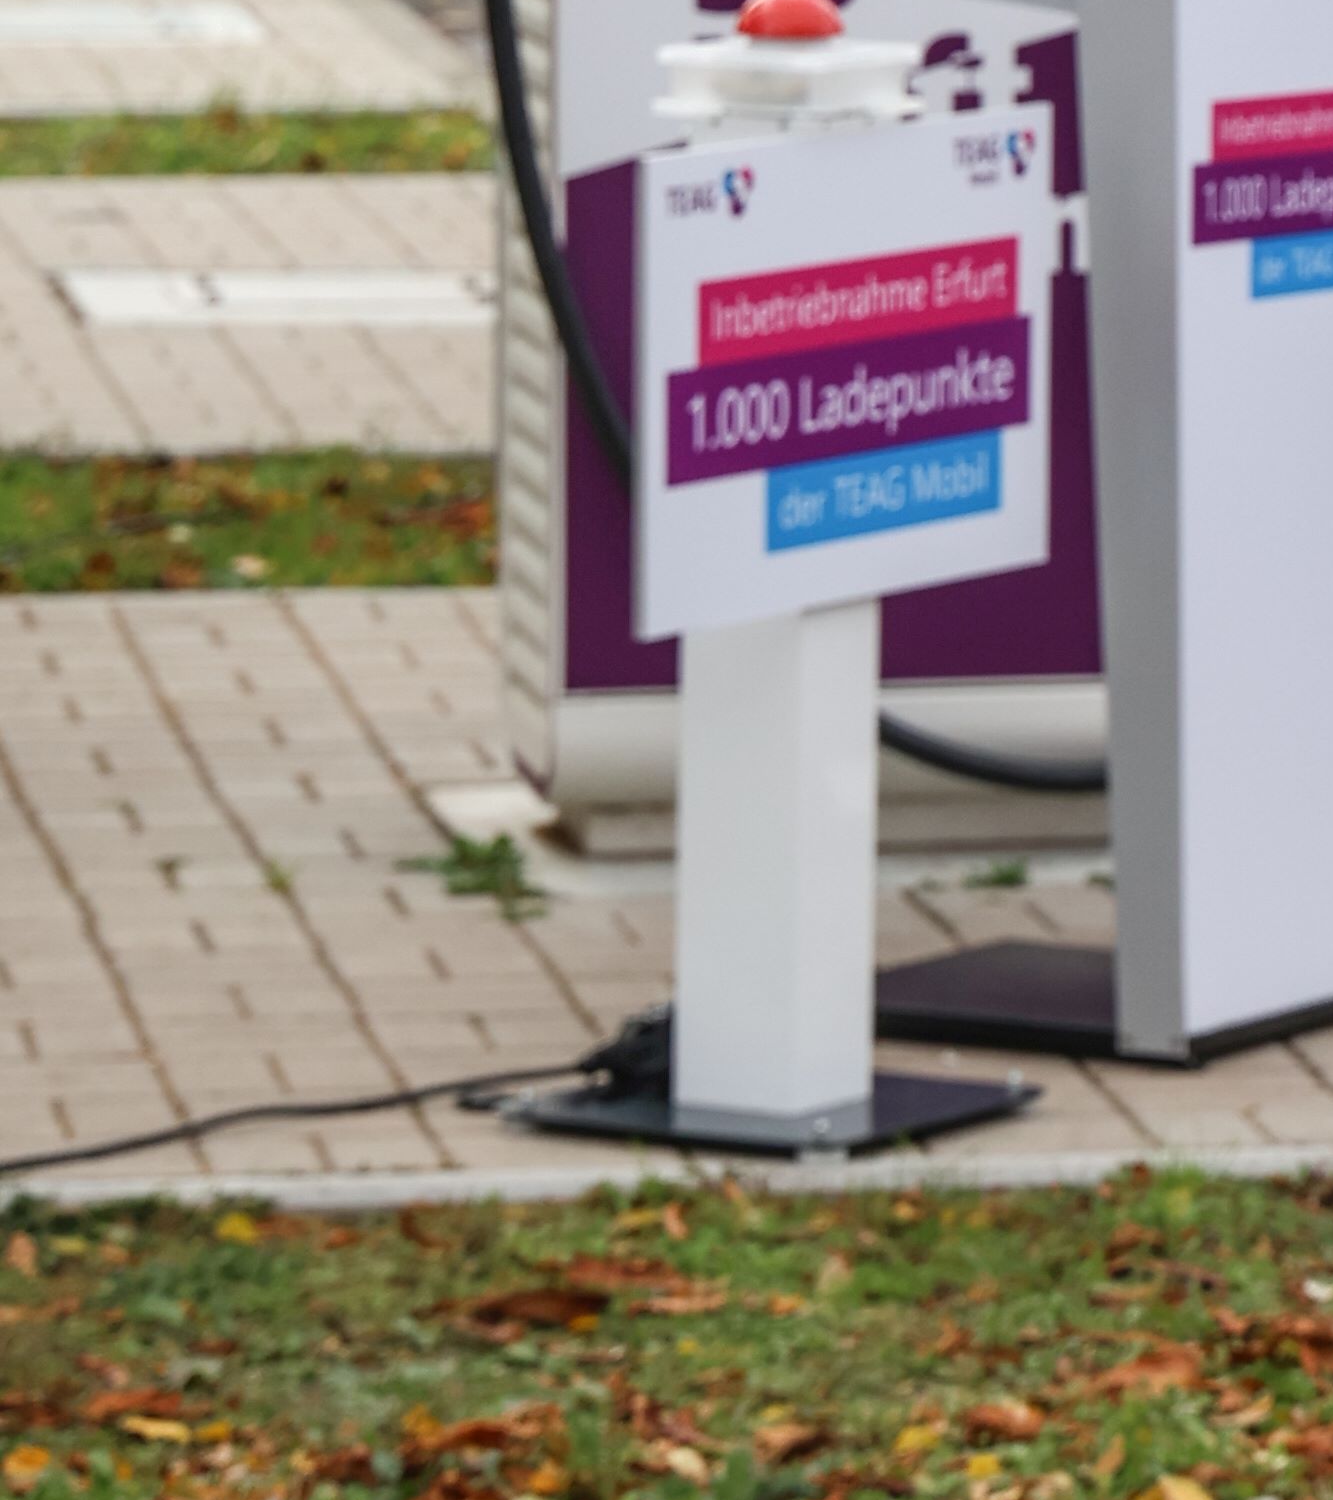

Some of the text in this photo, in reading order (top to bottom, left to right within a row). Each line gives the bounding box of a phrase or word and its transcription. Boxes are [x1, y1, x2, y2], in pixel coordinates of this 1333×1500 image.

[710, 257, 1008, 341] Inbetriebnahme Erfurt
[687, 346, 1015, 453] 1.000 Ladepunkte
[777, 450, 990, 531] der TEAG Mobil
